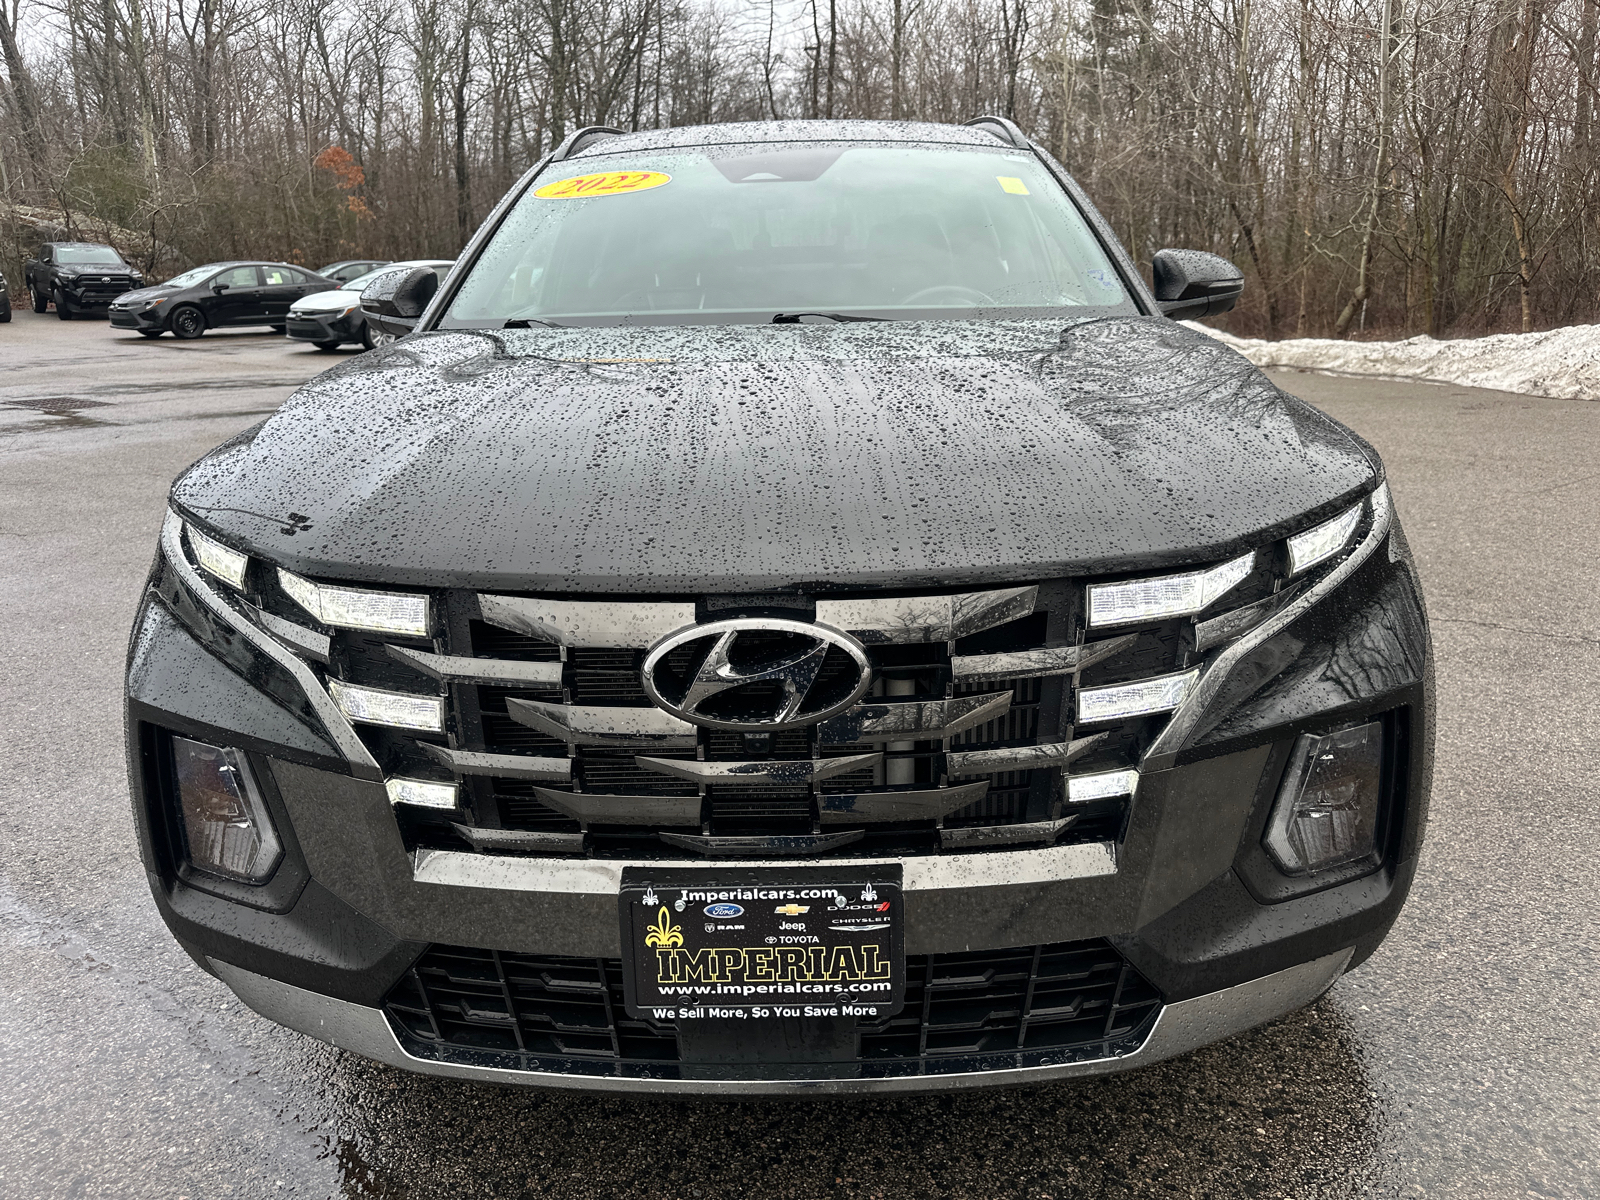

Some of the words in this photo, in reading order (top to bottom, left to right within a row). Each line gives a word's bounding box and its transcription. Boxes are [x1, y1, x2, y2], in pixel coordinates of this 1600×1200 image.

[552, 174, 650, 195] 2022
[680, 889, 838, 903] Imperialcars.com
[712, 906, 736, 916] Ford
[778, 921, 806, 932] Jeep
[779, 935, 820, 944] TOYOTA
[657, 945, 890, 983] IMPERIAL
[658, 982, 891, 995] www.imperialcars.com
[653, 1008, 675, 1018] We
[679, 1007, 704, 1018] Sell
[709, 1007, 748, 1019] More,
[751, 1006, 769, 1017] So
[773, 1006, 800, 1017] You
[804, 1005, 838, 1017] Save
[842, 1005, 877, 1016] More
